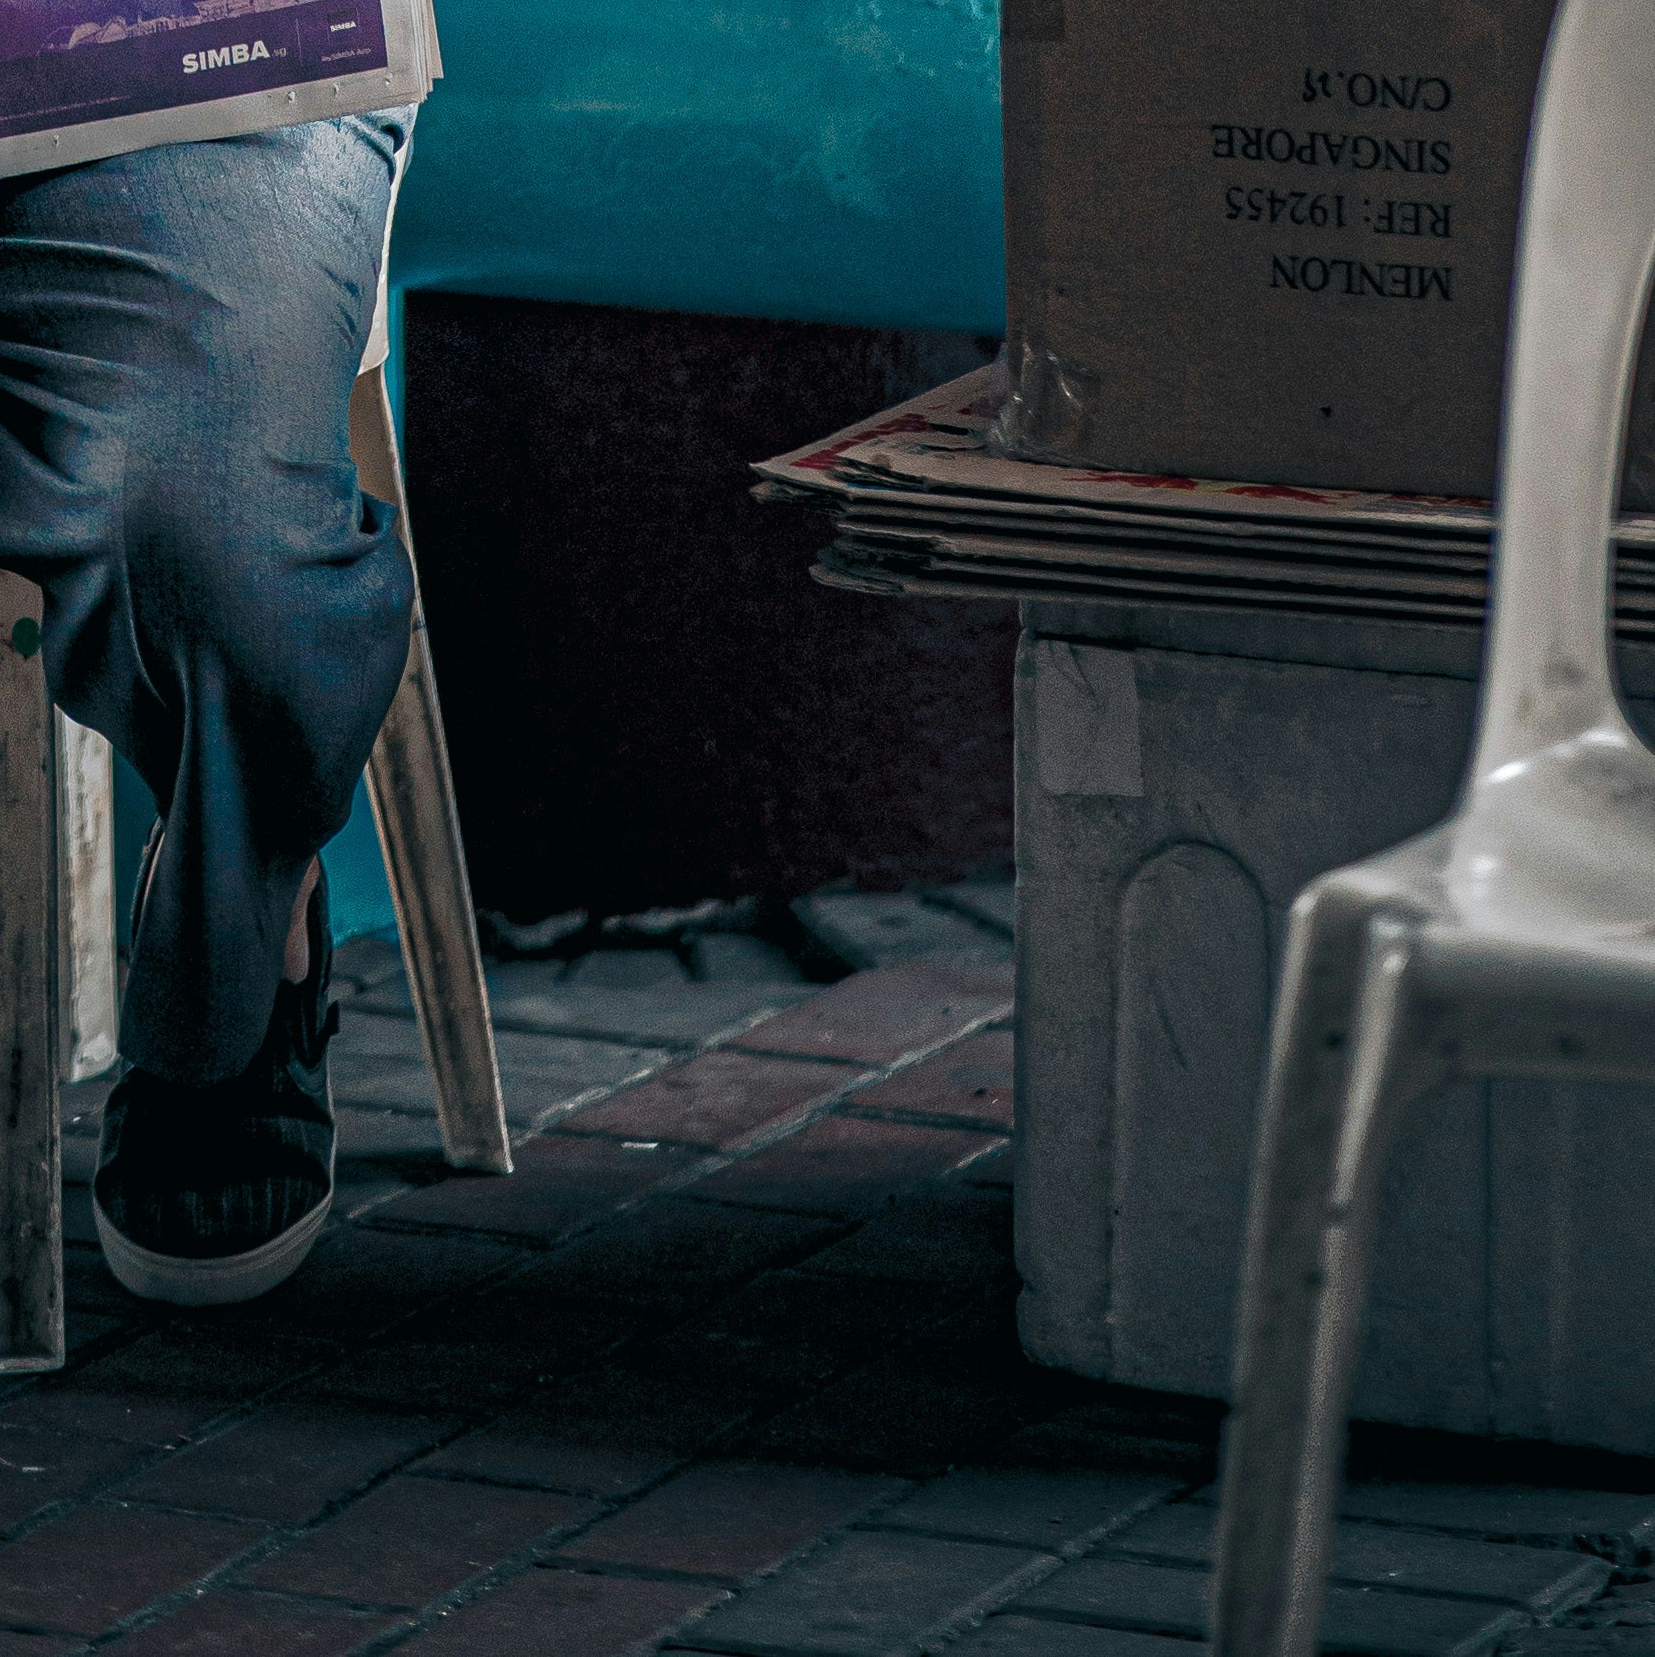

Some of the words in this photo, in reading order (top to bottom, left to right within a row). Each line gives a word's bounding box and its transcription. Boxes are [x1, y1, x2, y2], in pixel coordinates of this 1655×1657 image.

[330, 20, 357, 33] SIMBA
[1210, 124, 1452, 175] SINGAPORE
[1225, 186, 1346, 229] 192455
[1363, 198, 1453, 239] REF:
[1268, 254, 1454, 303] MENLON
